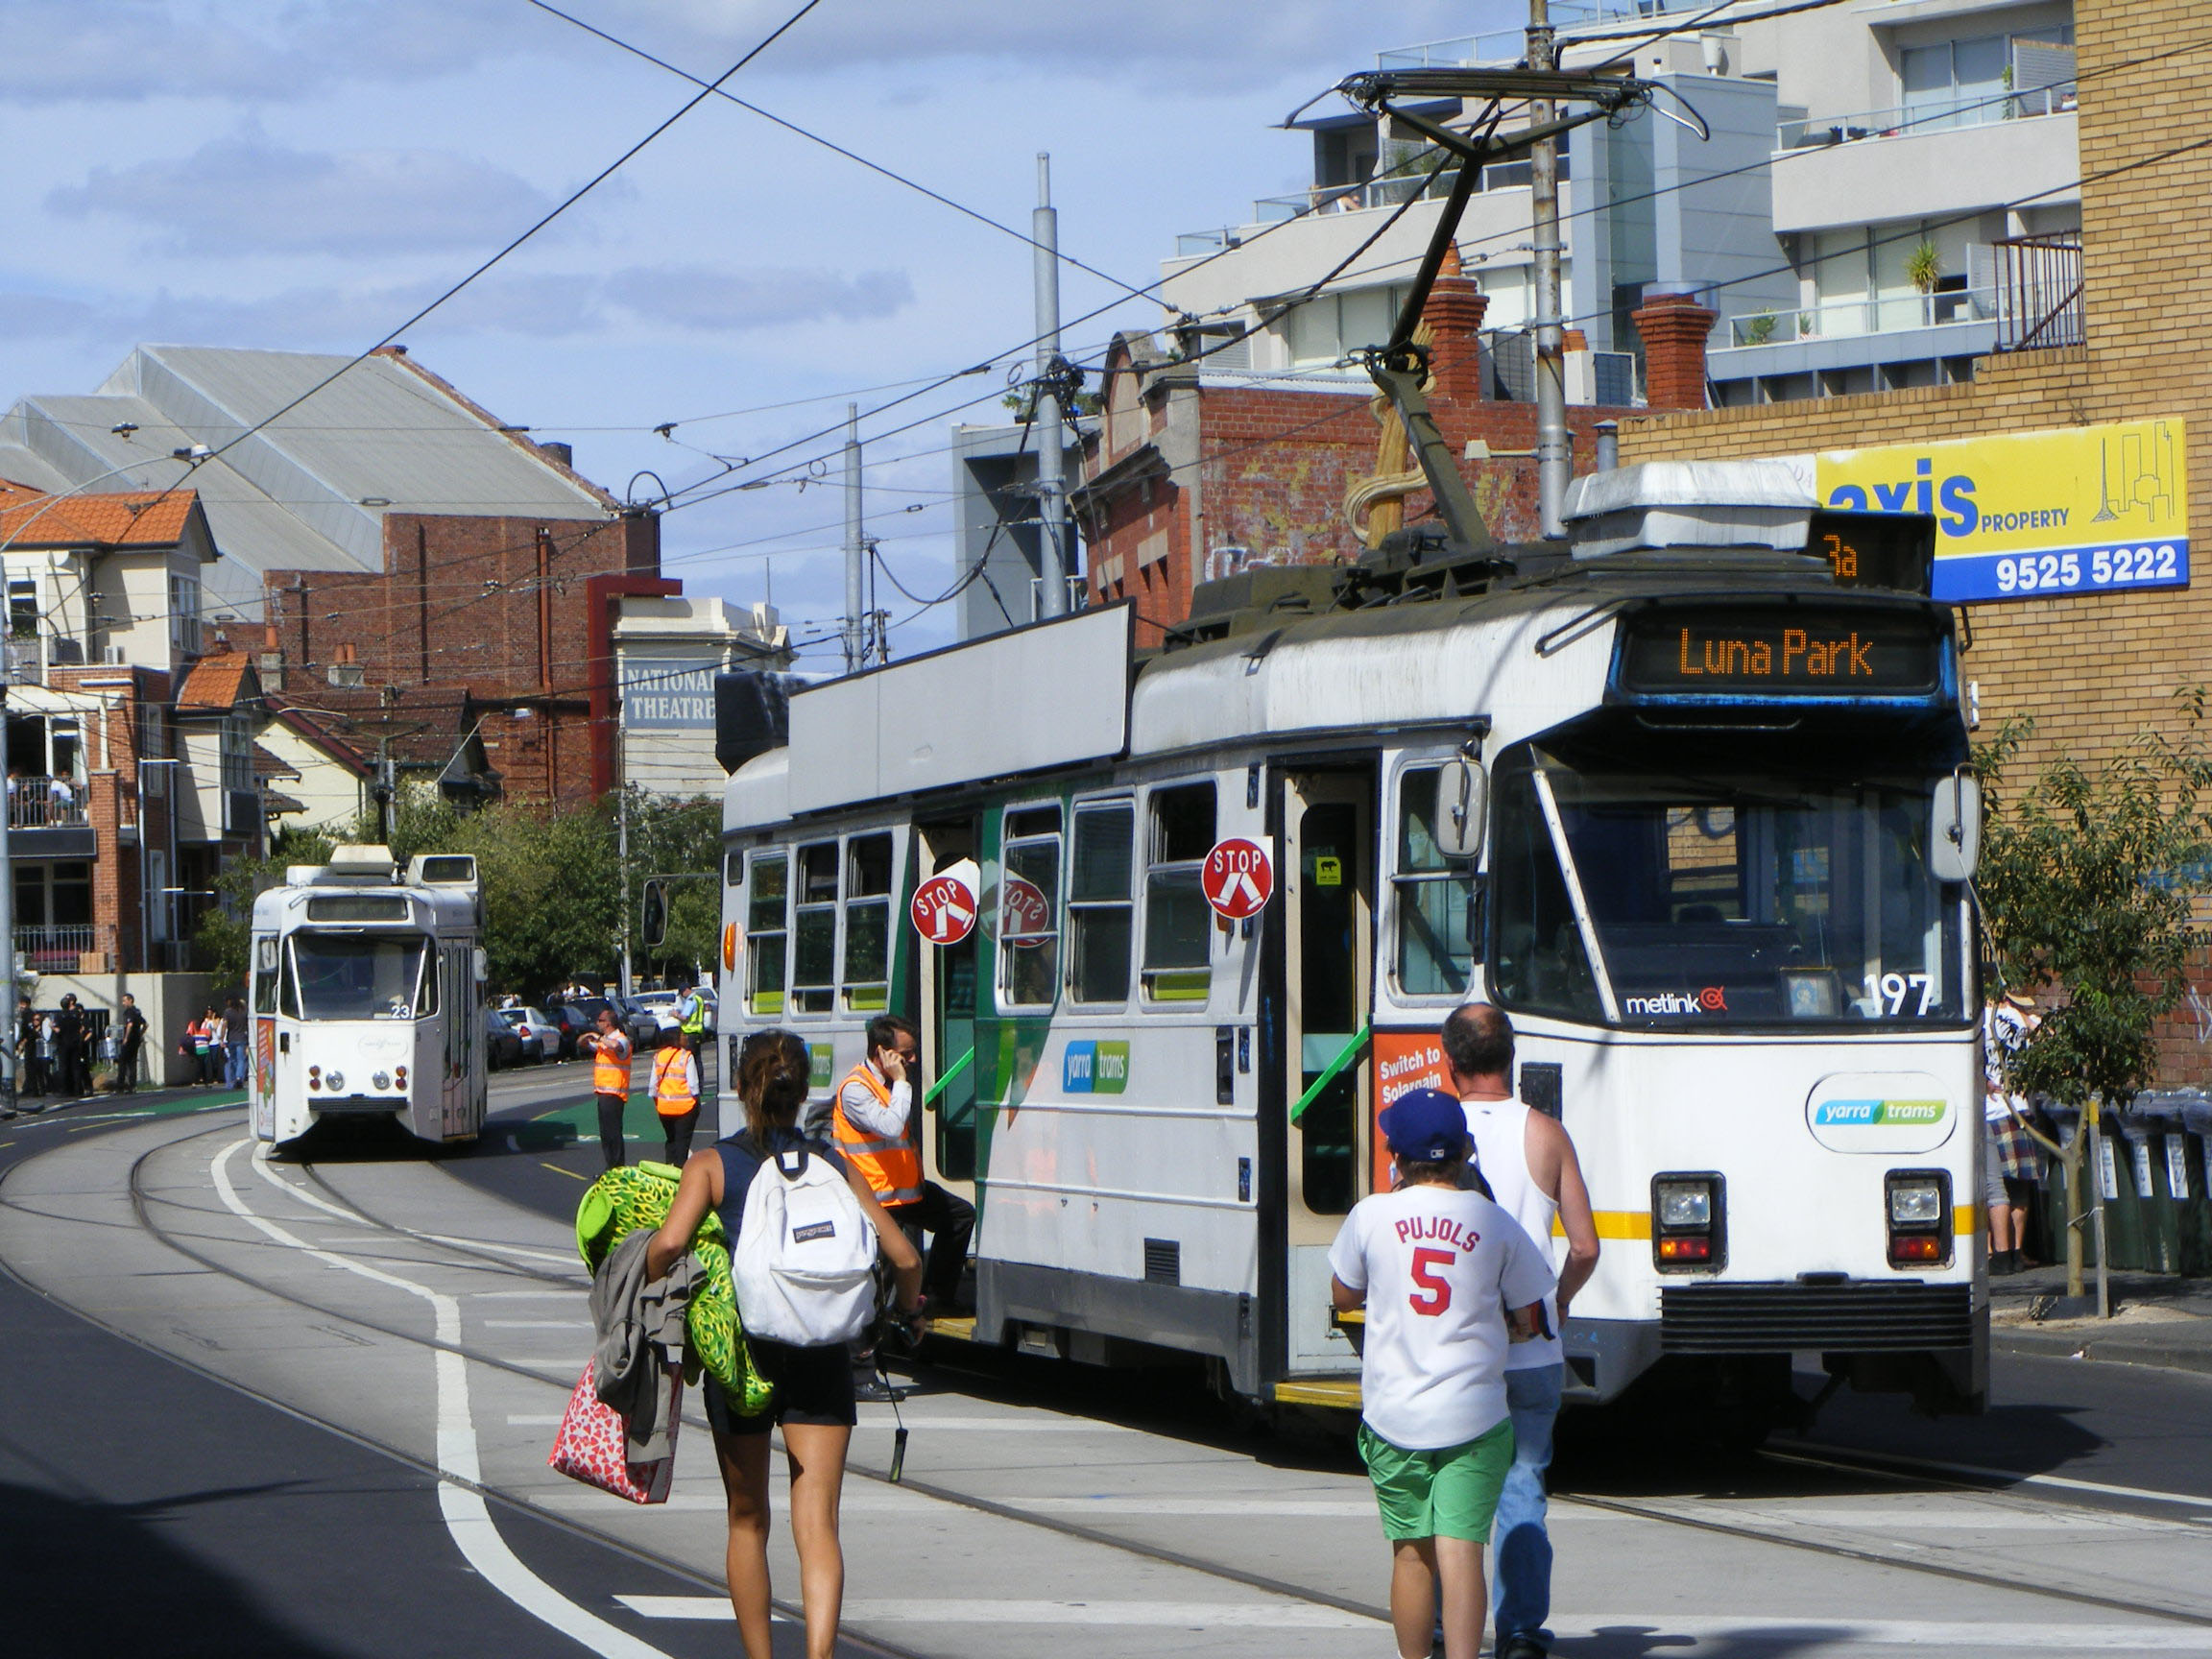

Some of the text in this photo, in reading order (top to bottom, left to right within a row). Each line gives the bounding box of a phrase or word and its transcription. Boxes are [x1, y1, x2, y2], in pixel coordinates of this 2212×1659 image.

[1982, 507, 2069, 533] PROPERTY
[1822, 534, 1857, 577] 3a
[1996, 544, 2177, 592] 9525 5222
[1681, 628, 1873, 675] Luna Park
[632, 697, 716, 719] THEATRE
[1214, 850, 1262, 873] STOP
[916, 879, 957, 916] STOP
[391, 1004, 410, 1020] 23
[1625, 993, 1701, 1014] metlink
[1863, 973, 1935, 1015] 197
[1067, 1048, 1124, 1087] yarra trams
[1381, 1047, 1441, 1080] Switch to
[1825, 1104, 1936, 1122] yarra trams
[1395, 1216, 1480, 1252] PUJOLS
[1409, 1247, 1455, 1316] 5
